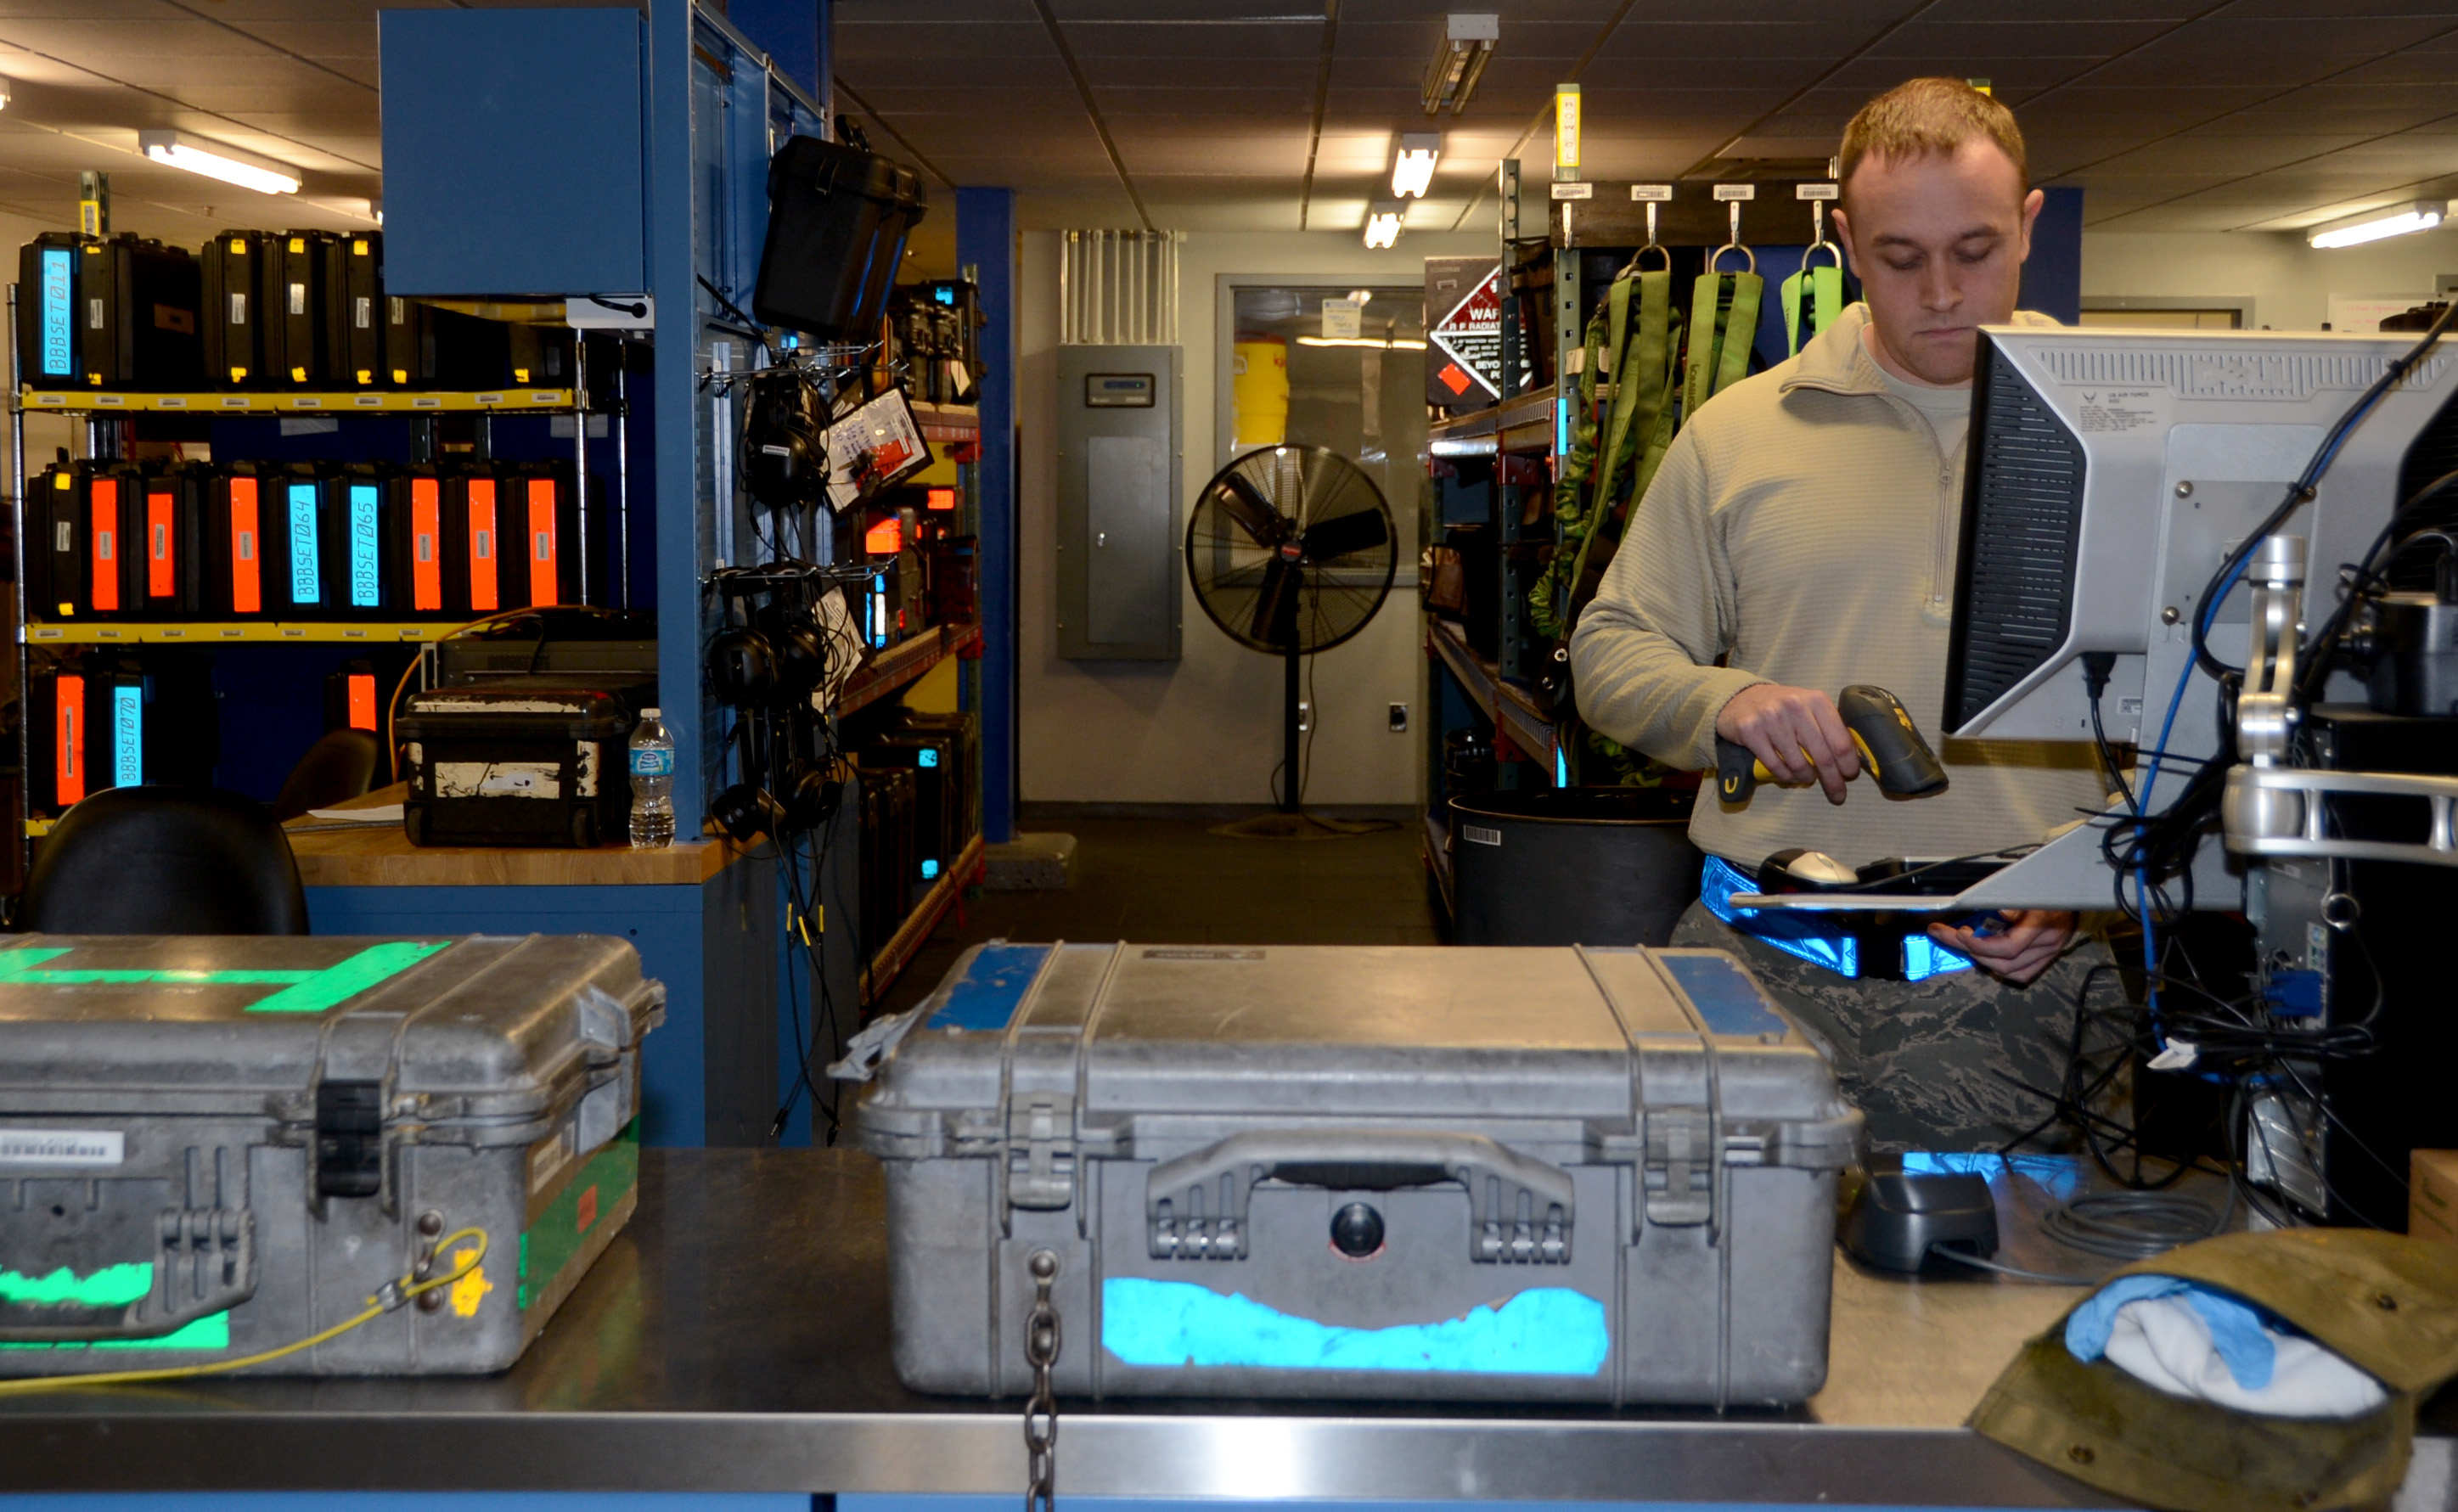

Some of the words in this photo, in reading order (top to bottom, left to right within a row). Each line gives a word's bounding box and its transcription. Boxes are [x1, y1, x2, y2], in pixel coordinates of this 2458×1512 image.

[48, 261, 67, 370] BBBSET011
[1469, 322, 1500, 330] RADIAT
[1476, 360, 1500, 369] BEYO
[294, 498, 315, 596] BBBSET064
[356, 501, 376, 599] BBBSET065
[121, 696, 137, 782] BBBSET070
